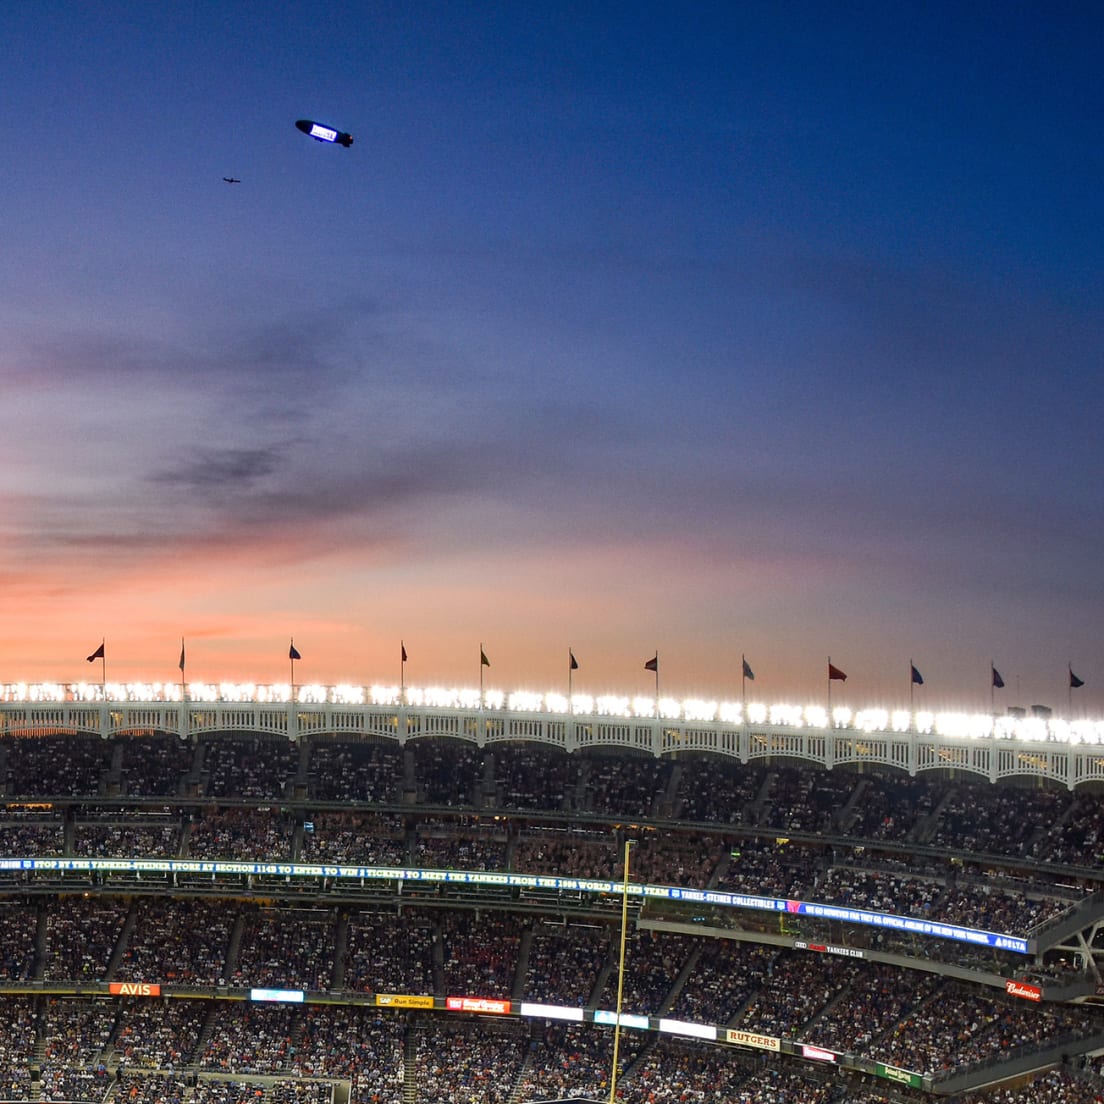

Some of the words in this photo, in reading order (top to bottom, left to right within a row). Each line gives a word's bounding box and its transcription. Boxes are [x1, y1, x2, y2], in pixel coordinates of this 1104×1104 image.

[34, 860, 57, 869] STOP
[59, 861, 70, 869] BY
[72, 861, 90, 870] THE
[172, 862, 201, 871] STORE
[202, 862, 214, 871] AT
[215, 863, 254, 873] SECTION
[279, 865, 291, 874] TO
[294, 866, 322, 875] ENTER
[325, 867, 338, 876] TO
[339, 868, 358, 877] WIN
[367, 869, 404, 880] TICKETS
[406, 870, 420, 880] TO
[421, 871, 447, 881] MEET
[448, 872, 466, 881] THE
[467, 873, 507, 884] YANKEES
[509, 875, 537, 886] FROM
[538, 877, 557, 887] THE
[578, 881, 612, 892] WORLD
[612, 883, 643, 894] SERIES
[644, 885, 669, 897] TEAM
[732, 896, 775, 909] COLLECTIBLES
[1003, 939, 1027, 951] DELTA
[827, 946, 849, 956] YANKEES
[850, 950, 863, 958] CLUB
[119, 984, 151, 996] AVIS
[1006, 981, 1040, 1000] Budweiser
[729, 1031, 777, 1048] RUTGERS
